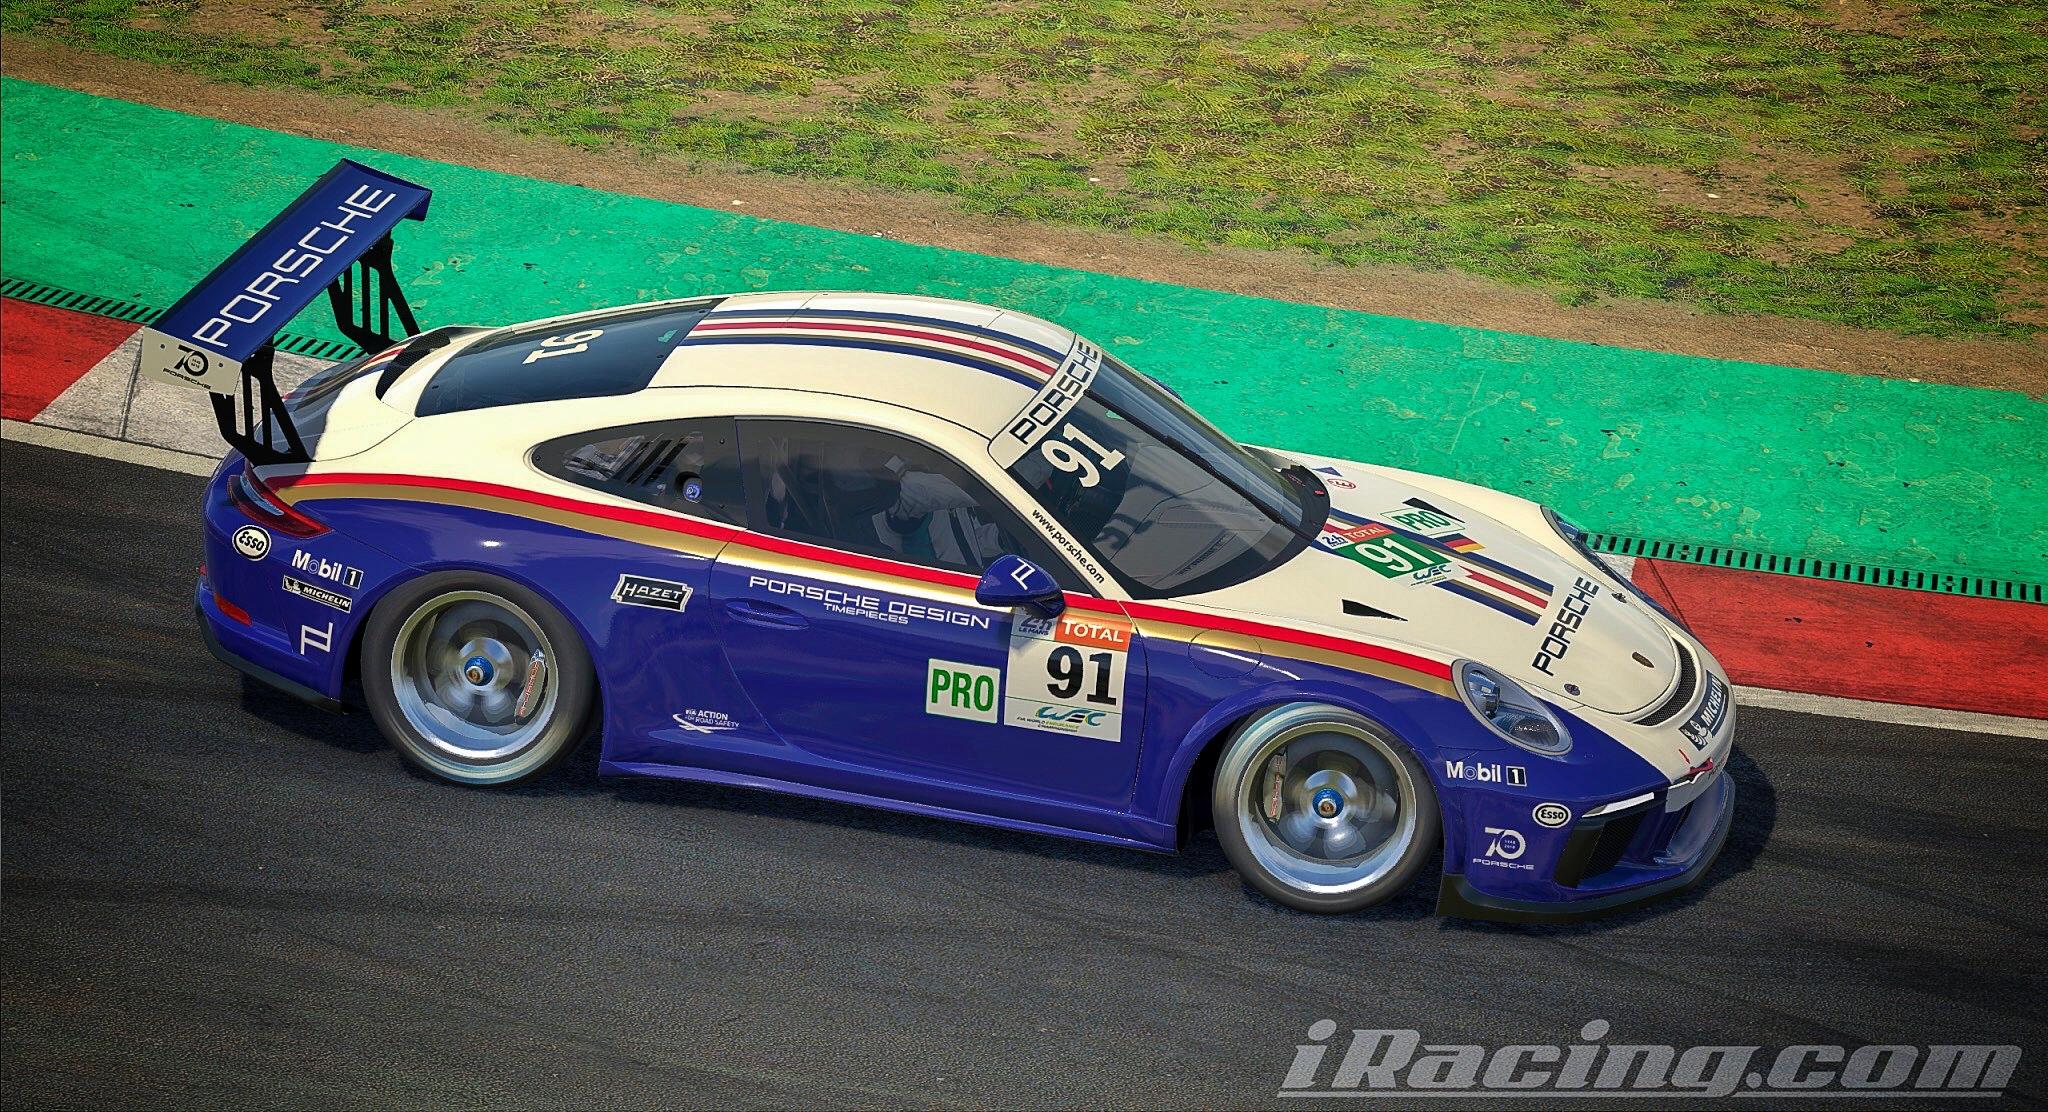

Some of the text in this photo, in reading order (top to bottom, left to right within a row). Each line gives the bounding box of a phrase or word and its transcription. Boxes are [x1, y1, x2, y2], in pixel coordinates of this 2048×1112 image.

[192, 184, 397, 348] PORSCHE
[174, 344, 209, 377] 70
[522, 329, 604, 365] 91
[163, 367, 211, 390] PORSCHE
[1009, 341, 1098, 445] PORSCHE
[1041, 422, 1126, 488] 91
[1343, 526, 1387, 540] TOTAL
[1391, 510, 1451, 531] PRO
[1032, 508, 1105, 584] www.porsche.com
[1354, 537, 1436, 572] 91
[292, 549, 343, 582] Mobil
[1412, 564, 1452, 581] WEC
[303, 586, 351, 608] MICHELIN
[622, 582, 683, 599] HAZET
[749, 575, 990, 629] PORSCHE DESIGN
[823, 602, 909, 625] TIMEPIECES
[1531, 576, 1600, 677] PORSCHE
[1062, 619, 1124, 643] TOTAL
[931, 668, 995, 713] PRO
[1046, 645, 1118, 706] 91
[697, 709, 729, 721] ACTION
[1035, 706, 1107, 727] WEC
[1700, 674, 1723, 727] MICHELIN
[695, 716, 714, 725] ROAD
[714, 719, 740, 728] SAFETY
[1445, 760, 1502, 783] Mobil
[1484, 826, 1526, 860] 70
[1473, 858, 1535, 870] PORSCHE
